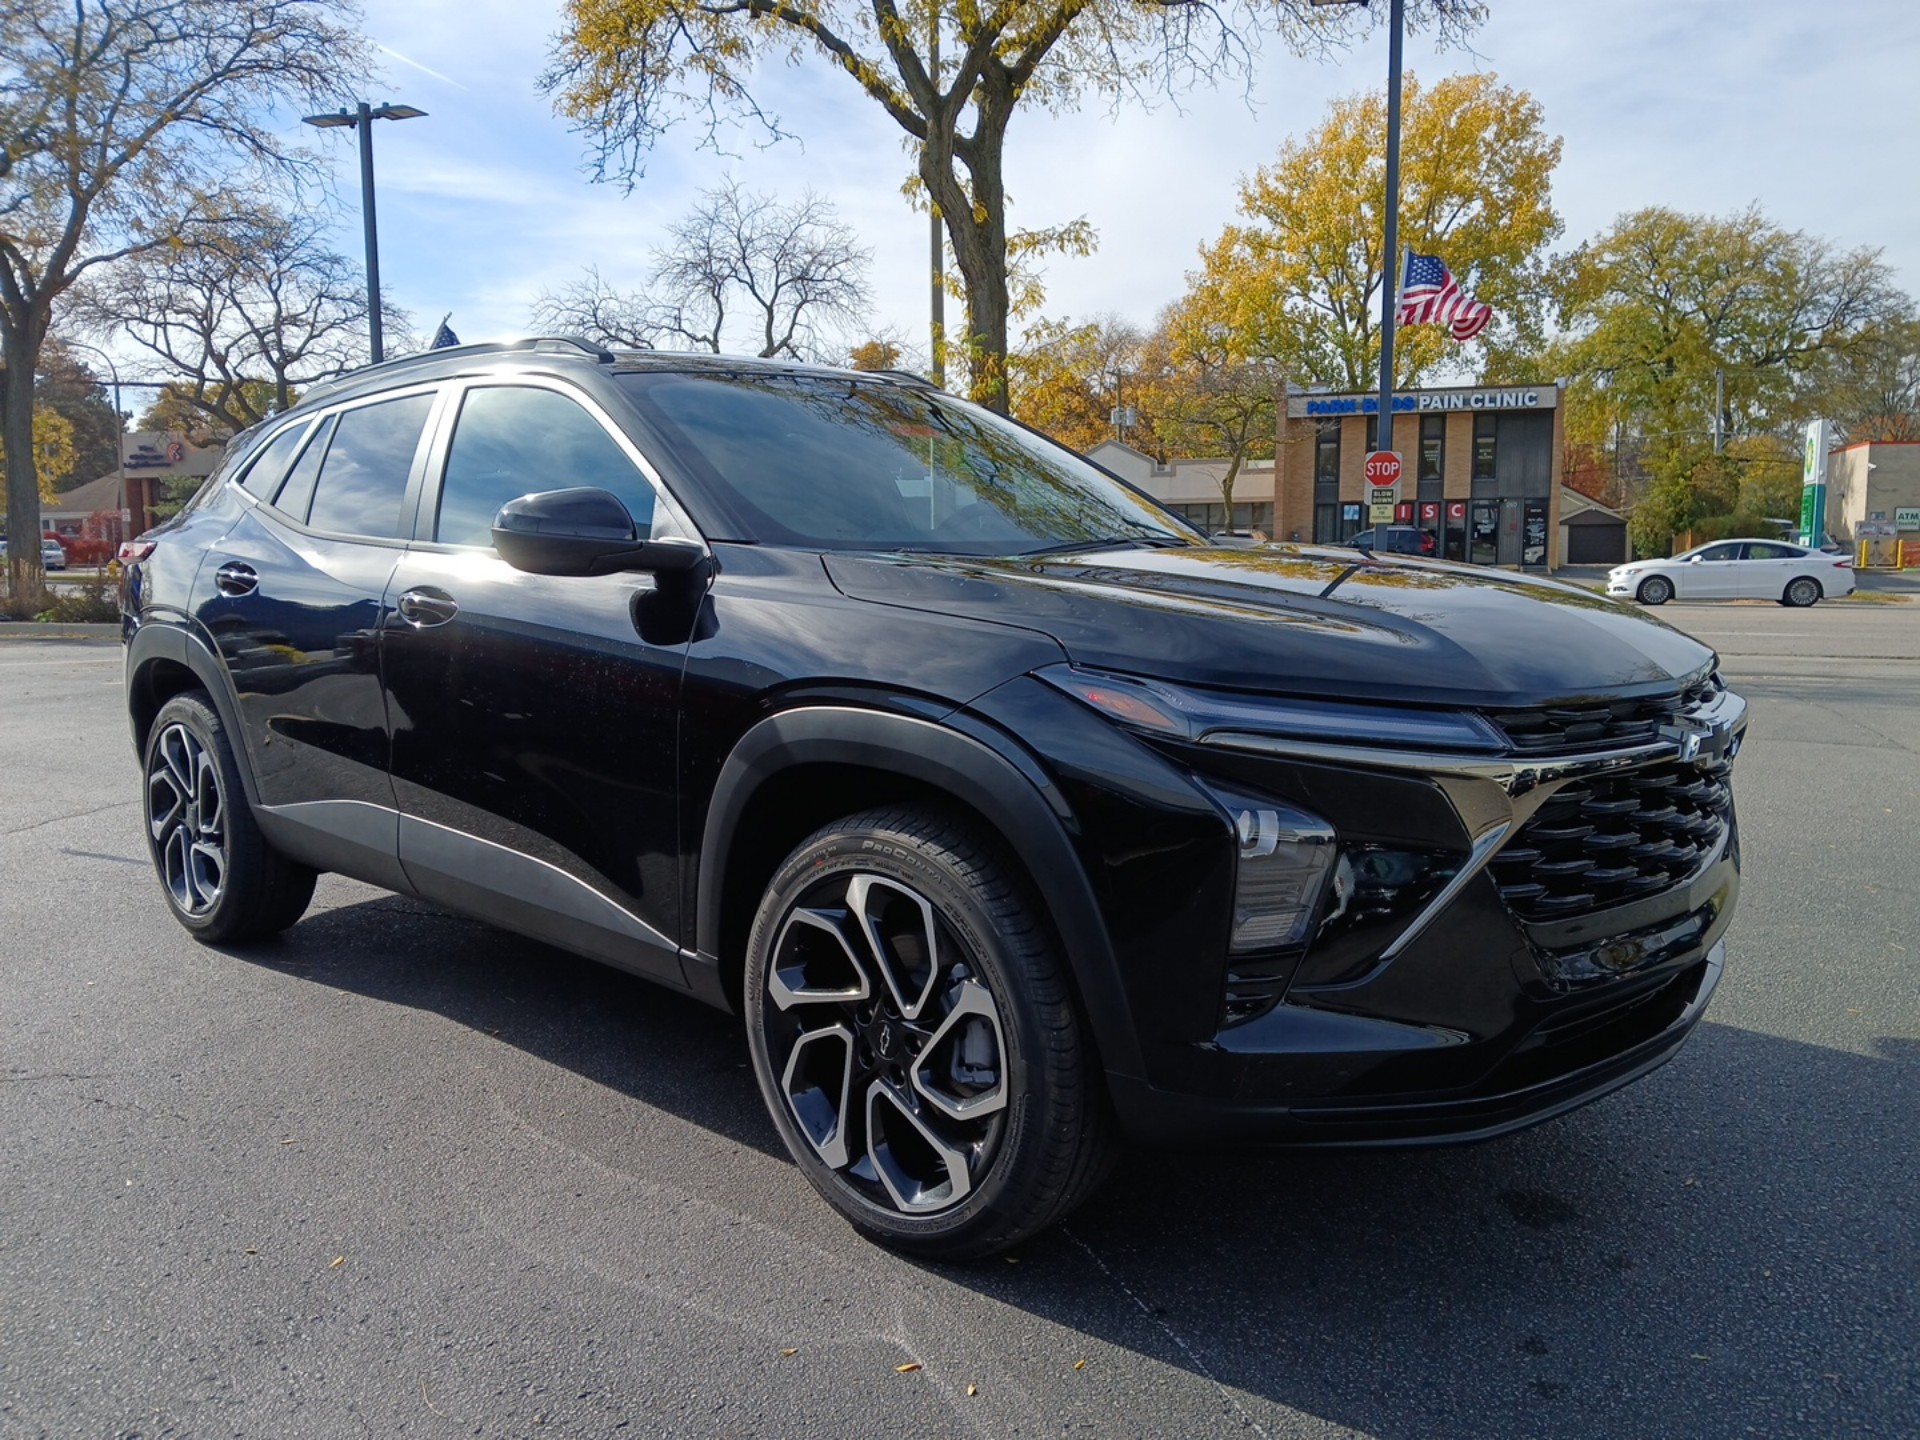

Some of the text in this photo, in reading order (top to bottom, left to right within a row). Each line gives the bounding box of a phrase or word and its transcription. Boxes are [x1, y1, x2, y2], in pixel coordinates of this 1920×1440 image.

[1362, 396, 1416, 412] BOS
[1419, 394, 1463, 410] PAIN
[1470, 391, 1537, 408] CLINIC
[1366, 461, 1399, 476] STOP
[1898, 512, 1919, 520] ATM
